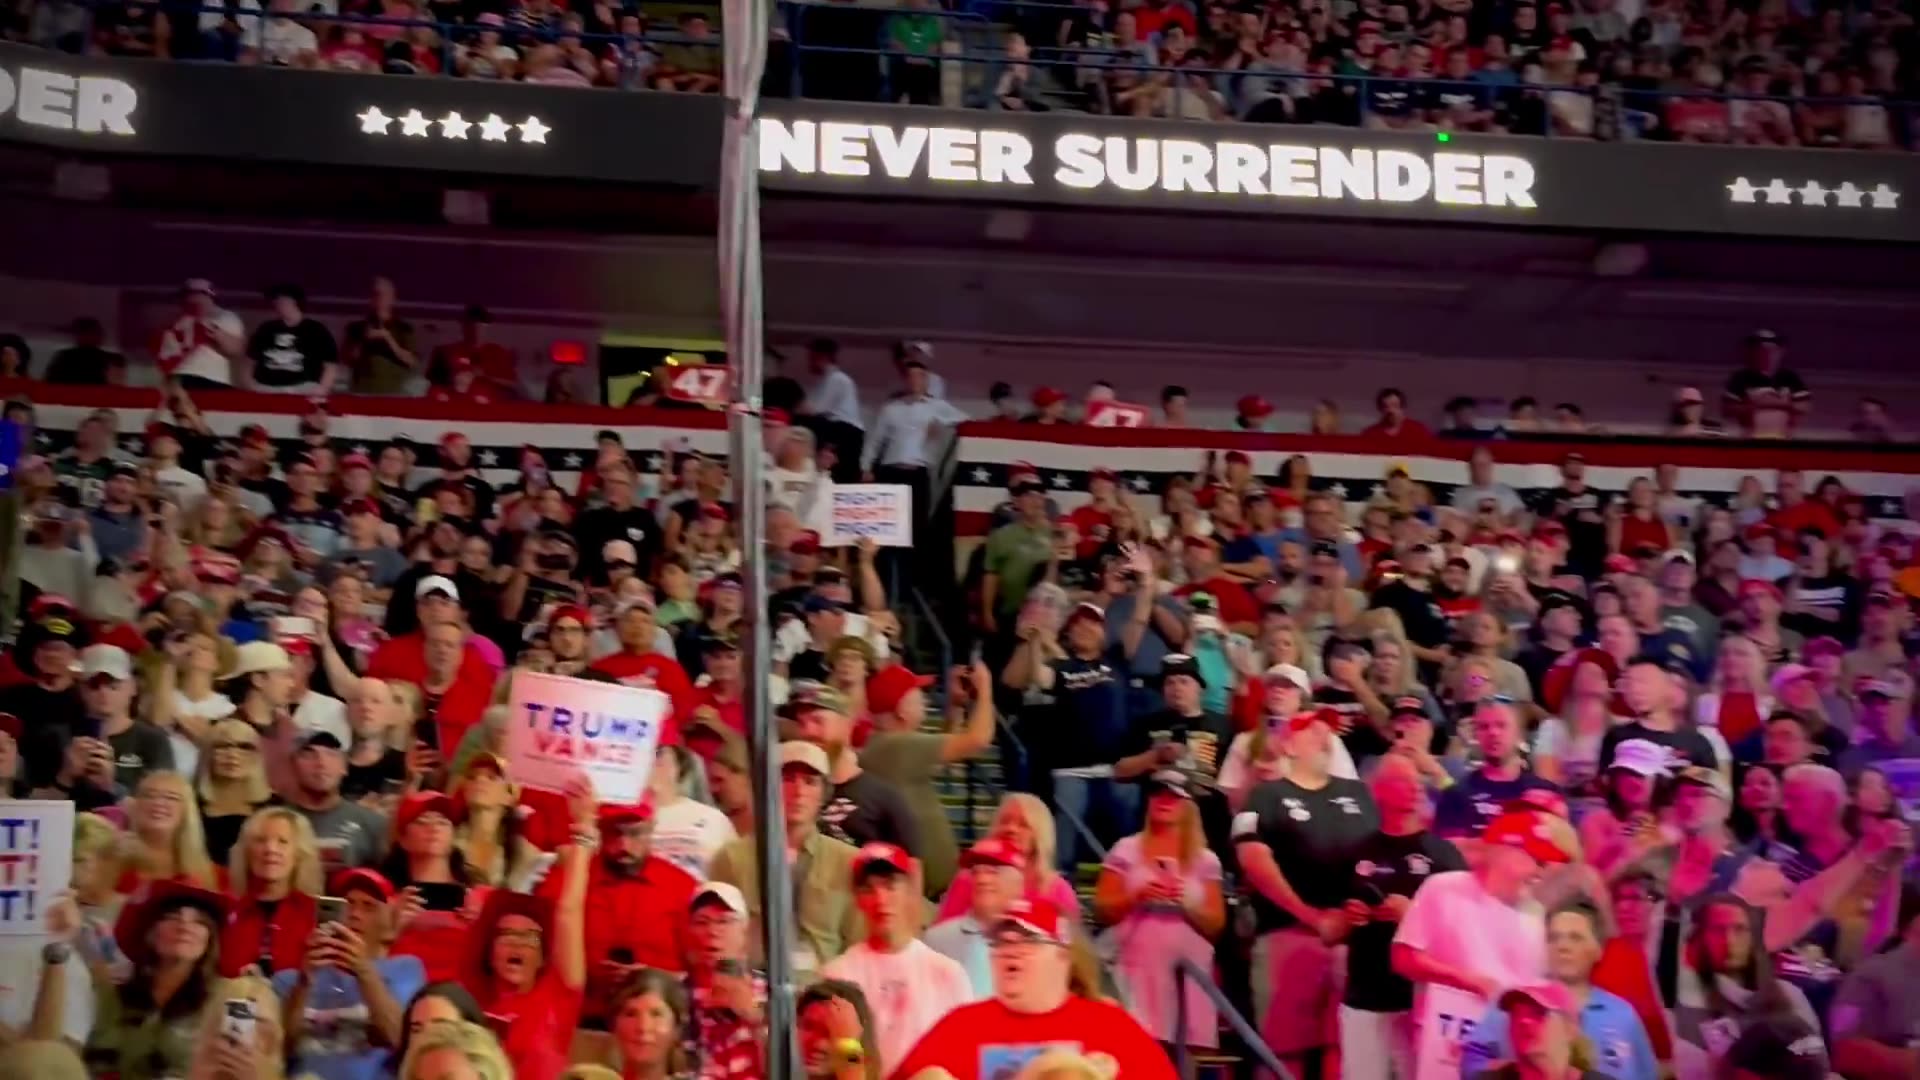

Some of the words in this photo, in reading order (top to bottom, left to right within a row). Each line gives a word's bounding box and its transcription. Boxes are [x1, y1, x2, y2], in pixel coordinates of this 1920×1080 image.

[0, 66, 137, 135] ER
[758, 118, 1035, 185] NEVER
[1054, 132, 1539, 208] SURRENDER
[671, 367, 726, 397] 47
